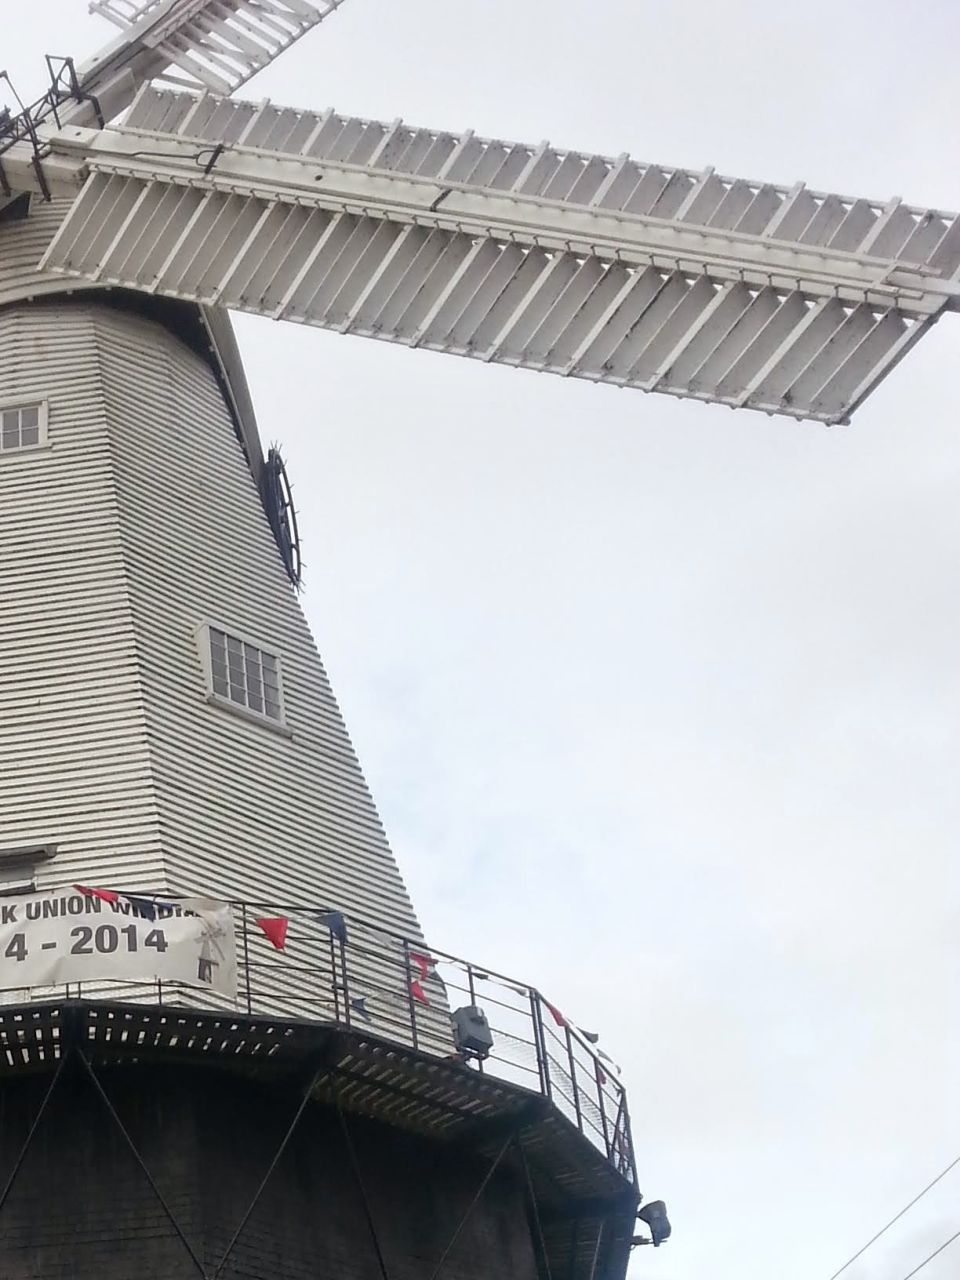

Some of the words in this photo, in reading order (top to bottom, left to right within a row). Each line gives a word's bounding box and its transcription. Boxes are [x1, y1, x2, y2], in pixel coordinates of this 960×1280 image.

[25, 894, 102, 920] UNION
[41, 942, 57, 950] -
[70, 924, 169, 955] 2014
